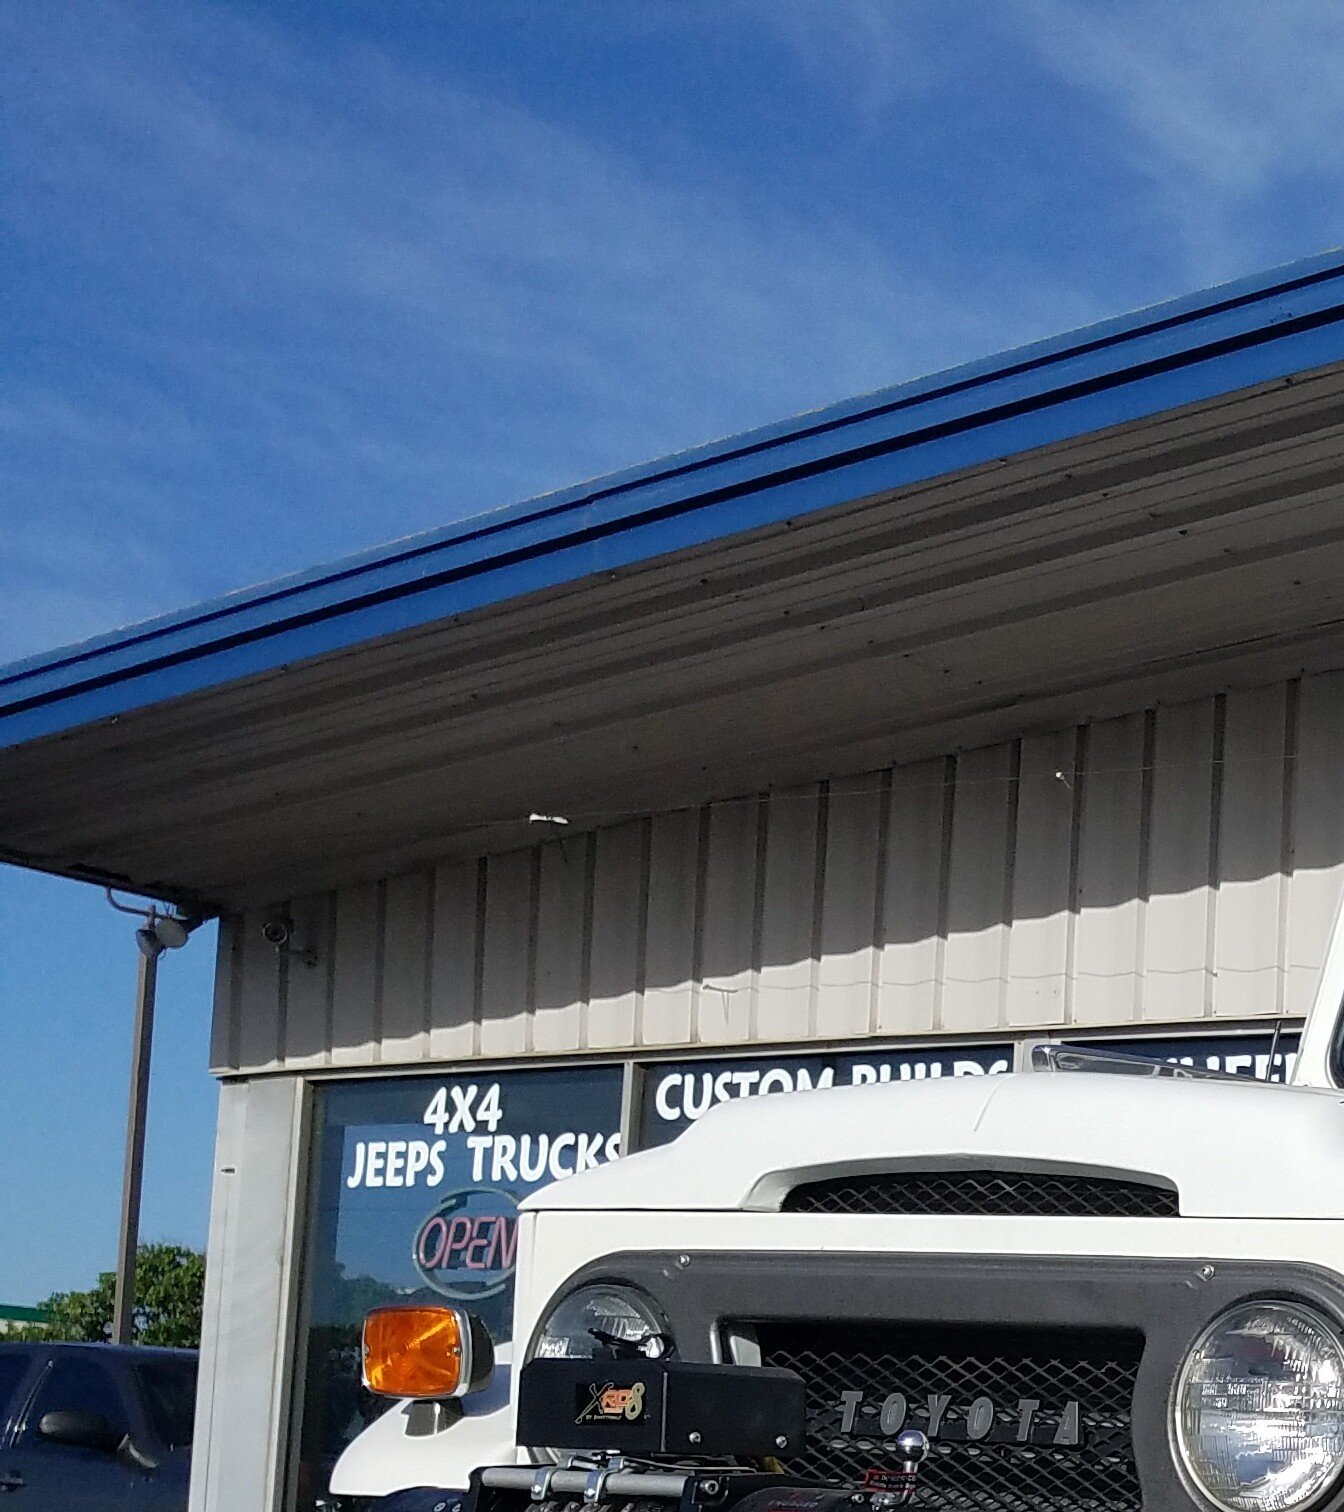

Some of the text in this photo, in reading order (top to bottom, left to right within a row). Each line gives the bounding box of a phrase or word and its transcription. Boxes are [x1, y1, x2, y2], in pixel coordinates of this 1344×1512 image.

[424, 1082, 503, 1135] 4X4
[347, 1139, 447, 1189] JEEPS
[418, 1216, 519, 1269] OPEN
[841, 1391, 1080, 1446] TOYOTA
